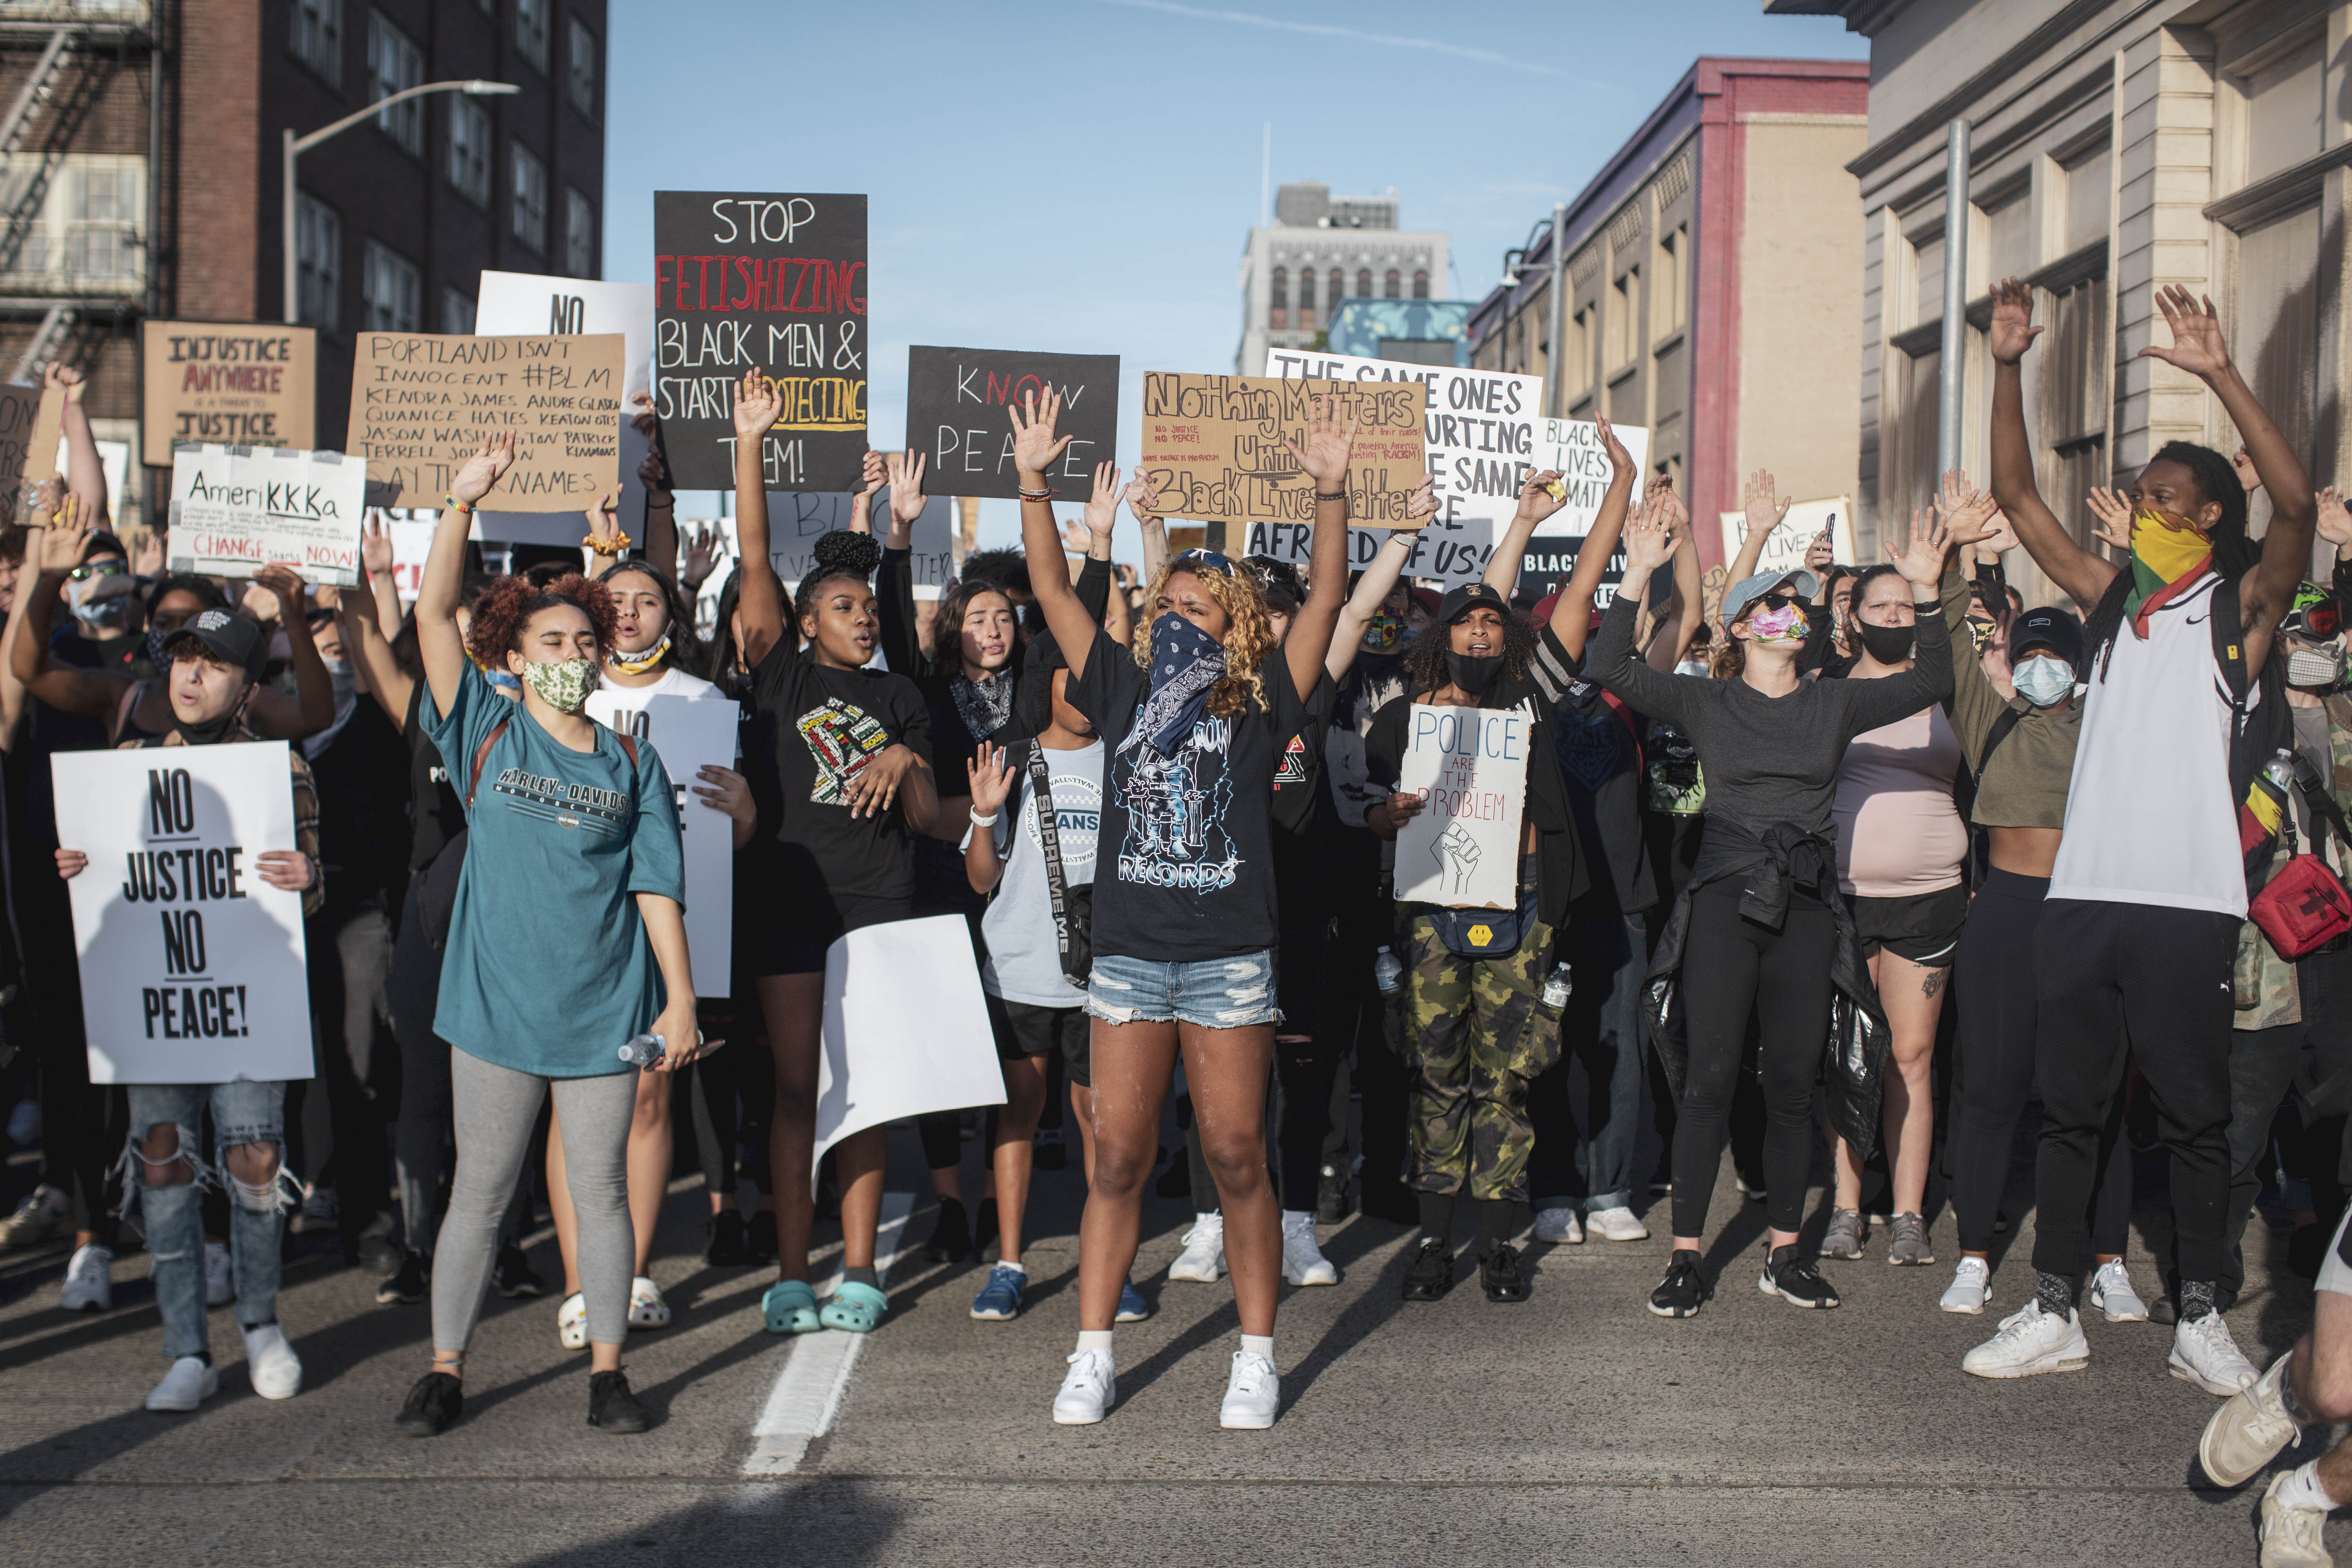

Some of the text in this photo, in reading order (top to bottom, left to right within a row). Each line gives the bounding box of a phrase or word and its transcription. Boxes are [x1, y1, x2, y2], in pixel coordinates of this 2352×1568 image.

[713, 198, 815, 244] STOP
[655, 254, 867, 315] FETISHIZING
[550, 293, 584, 335] NO
[168, 336, 290, 362] INJUSTICE
[372, 336, 572, 364] PORTLAND ISN'T
[658, 318, 862, 371] BLACK MEN &
[182, 364, 283, 393] ANYWHERE
[374, 363, 610, 390] INNOCENT #BLM
[958, 364, 1085, 410] KNOW
[366, 388, 621, 411] KENDRA JAMES ANDRE GLADEN
[658, 376, 736, 421] START
[1145, 373, 1414, 439] Nothing Matters
[1448, 376, 1522, 415] ONES
[176, 412, 276, 436] JUSTICE
[360, 425, 424, 441] JASON
[565, 431, 616, 445] PATRICK
[366, 409, 616, 426] QUANICE HAYES KEATON OTIS
[1172, 425, 1199, 434] JUSTICE
[1368, 427, 1376, 435] of
[1379, 427, 1395, 436] their
[1399, 427, 1421, 437] names!
[1424, 413, 1532, 455] URTING
[1547, 420, 1606, 448] BLACK
[359, 442, 439, 458] TERRELL
[1155, 434, 1200, 444] NO PEACE!
[1235, 428, 1305, 472] Until
[1358, 442, 1387, 452] protesting
[1391, 441, 1419, 450] America
[1381, 449, 1420, 461] RACISM!
[366, 459, 417, 493] SAY
[509, 471, 596, 495] NAMES
[717, 437, 805, 485] TEM!
[1556, 448, 1609, 478] LIVES
[189, 470, 340, 519] AmeriKKKa
[1146, 468, 1243, 517] Black
[1455, 457, 1531, 501] SAME
[194, 533, 265, 559] CHANGE
[307, 545, 359, 568] NOW!
[1524, 554, 1577, 572] BLAC
[614, 710, 650, 741] NO
[1416, 711, 1520, 760] POLICE
[807, 728, 839, 768] FAIRNESS
[1452, 757, 1474, 771] ARE
[1444, 771, 1479, 789] THE
[147, 768, 195, 835] NO
[1417, 787, 1505, 822] PROBLEM
[1037, 794, 1062, 913] SUPREME
[122, 847, 247, 902] JUSTICE
[1118, 856, 1236, 889] RECORDS
[161, 909, 207, 975] NO
[141, 985, 249, 1040] PEACE!
